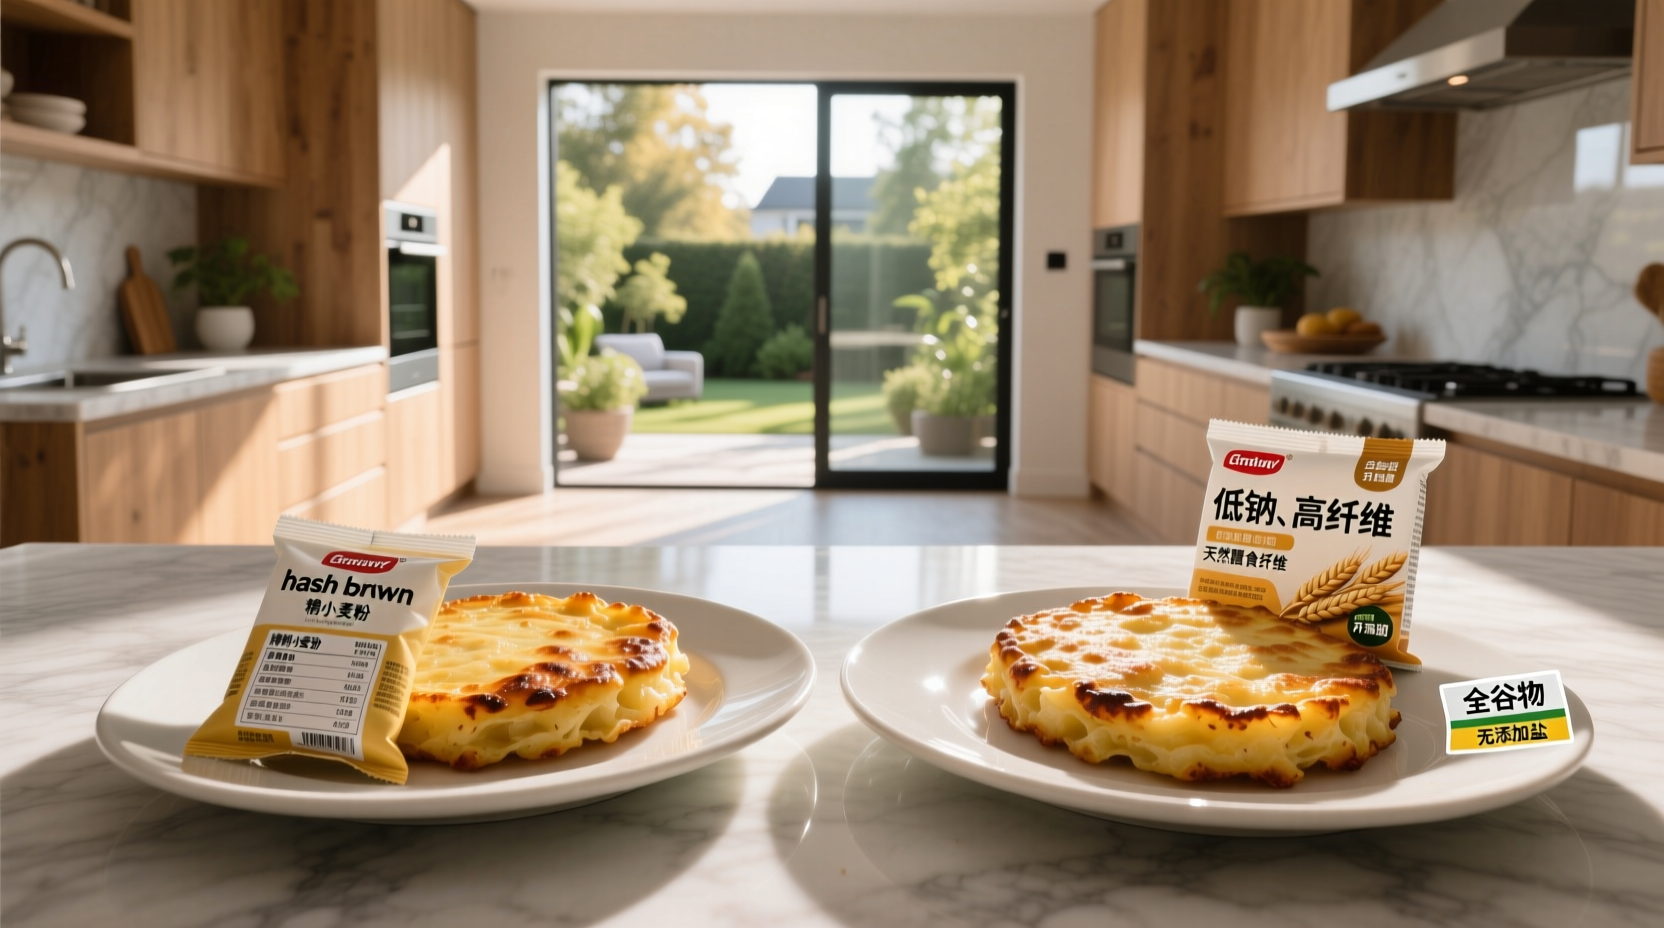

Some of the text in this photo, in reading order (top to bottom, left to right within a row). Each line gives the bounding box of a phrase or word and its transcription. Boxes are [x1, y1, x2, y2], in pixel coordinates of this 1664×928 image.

[1213, 487, 1394, 538] 低钠、高纤维
[281, 569, 339, 594] hash
[1463, 680, 1545, 715] 全谷物
[1477, 722, 1548, 746] 无添加盐
